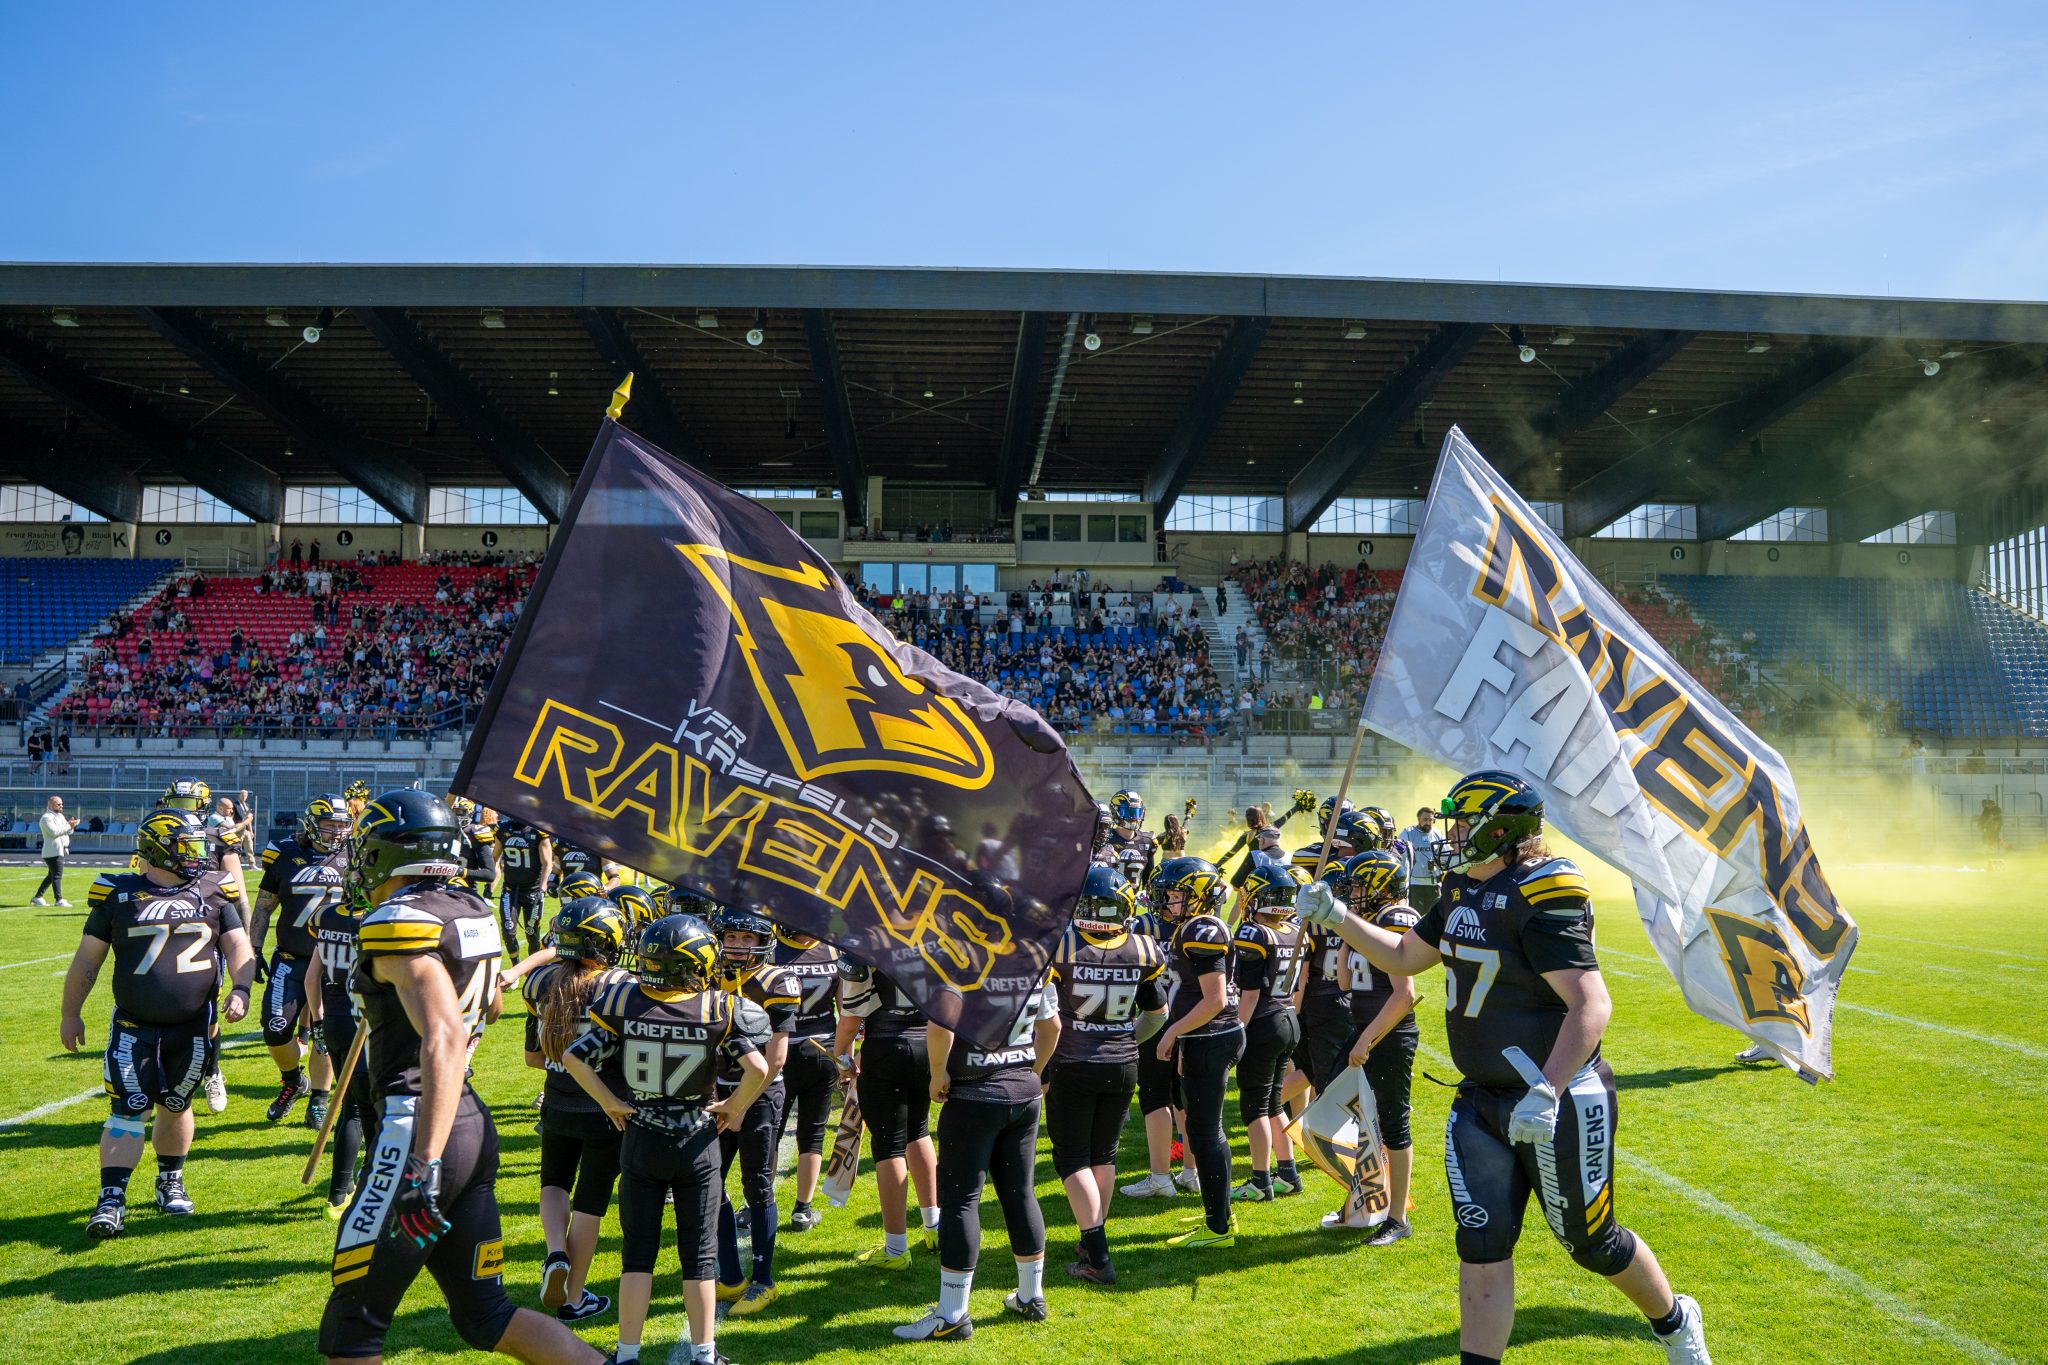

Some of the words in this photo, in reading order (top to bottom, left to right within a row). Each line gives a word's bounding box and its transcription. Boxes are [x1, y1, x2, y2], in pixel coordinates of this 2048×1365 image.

[158, 534, 168, 544] K
[687, 698, 747, 749] VFR
[672, 719, 900, 850] KREFELD
[504, 847, 531, 868] 91
[513, 698, 1012, 992] RAVENS
[562, 917, 572, 926] 99
[1079, 921, 1110, 931] Riddell
[1456, 924, 1486, 942] SWK
[128, 922, 213, 975] 72
[647, 942, 659, 954] 87
[1072, 966, 1141, 982] KREFELD
[1072, 983, 1138, 1021] 78
[624, 1019, 708, 1041] KREFELD
[623, 1038, 707, 1097] 87
[1585, 1104, 1604, 1184] RAVENS
[353, 1145, 401, 1234] RAVENS
